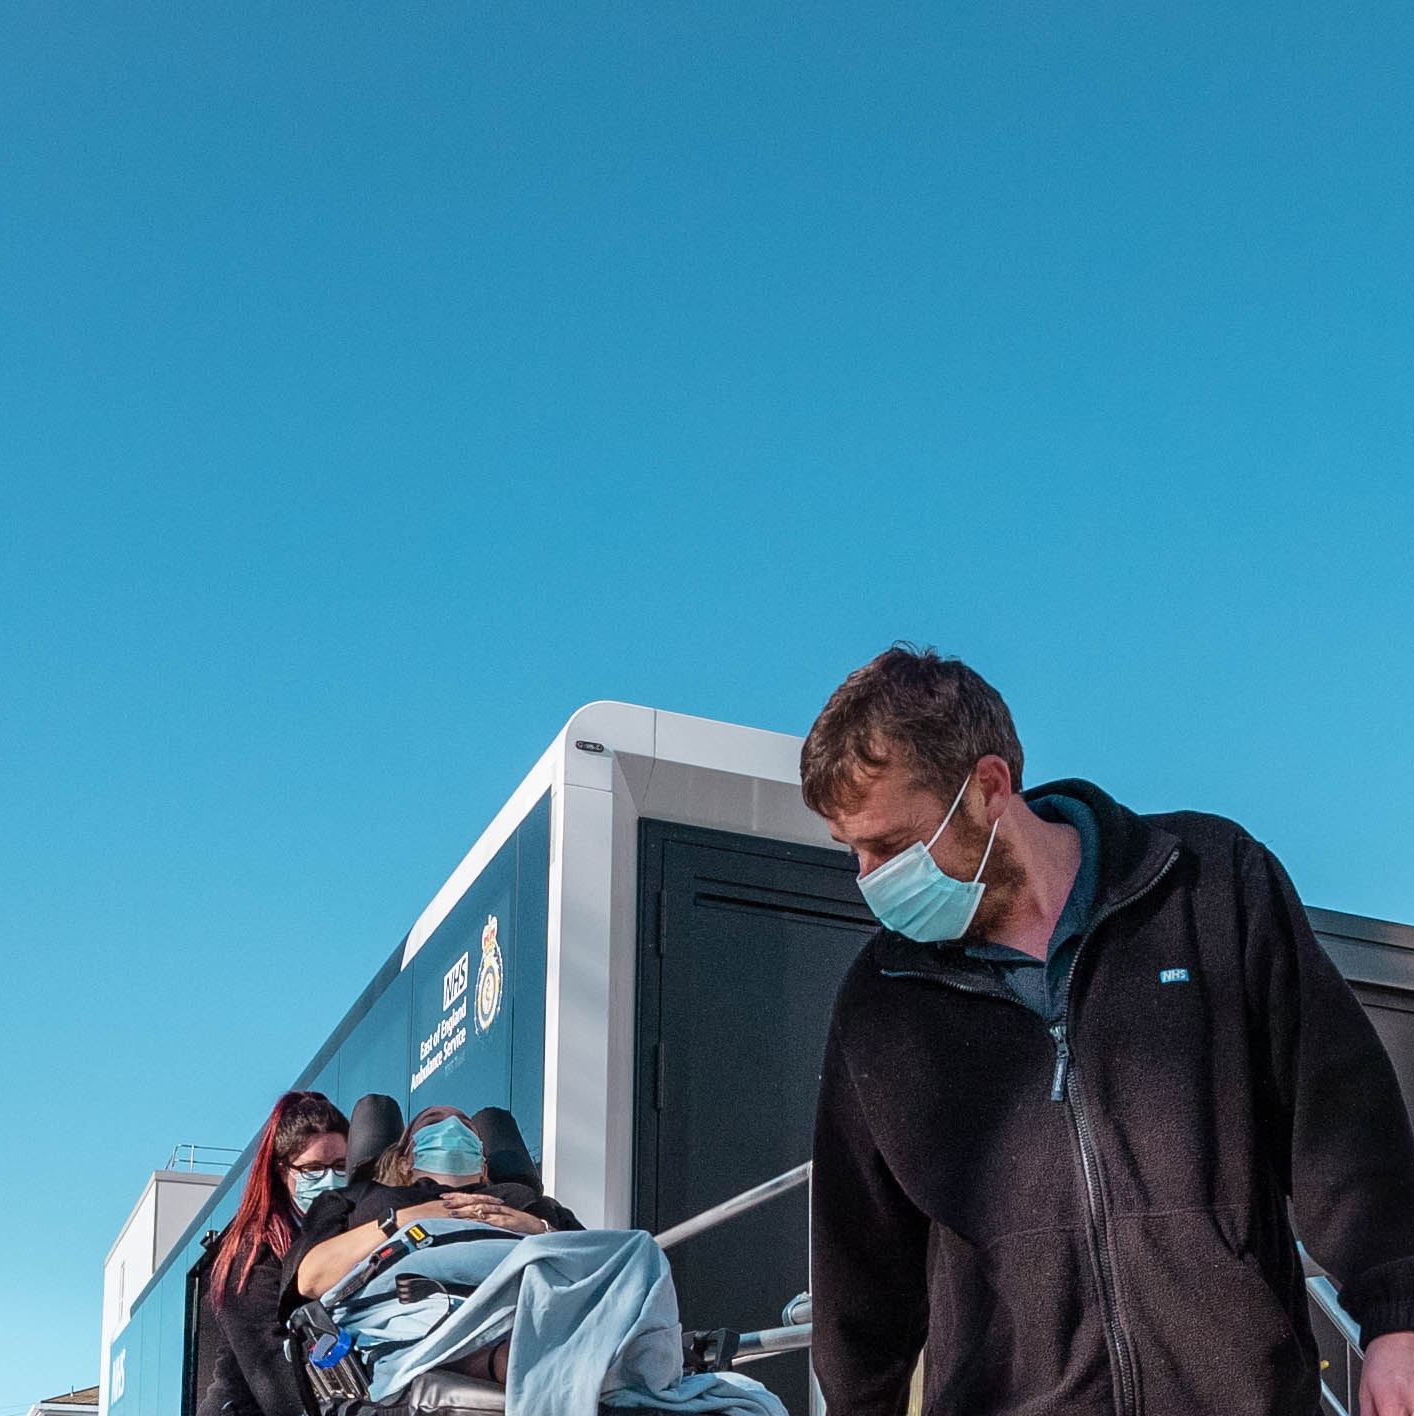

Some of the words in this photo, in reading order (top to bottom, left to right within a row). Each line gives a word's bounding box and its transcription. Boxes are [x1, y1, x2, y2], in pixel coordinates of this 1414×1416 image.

[444, 956, 467, 1003] NHS
[1162, 969, 1187, 982] NHS
[420, 1034, 433, 1061] East
[433, 1023, 441, 1047] of
[441, 996, 467, 1040] England
[411, 1050, 443, 1093] Ambulance
[443, 1027, 466, 1060] Service
